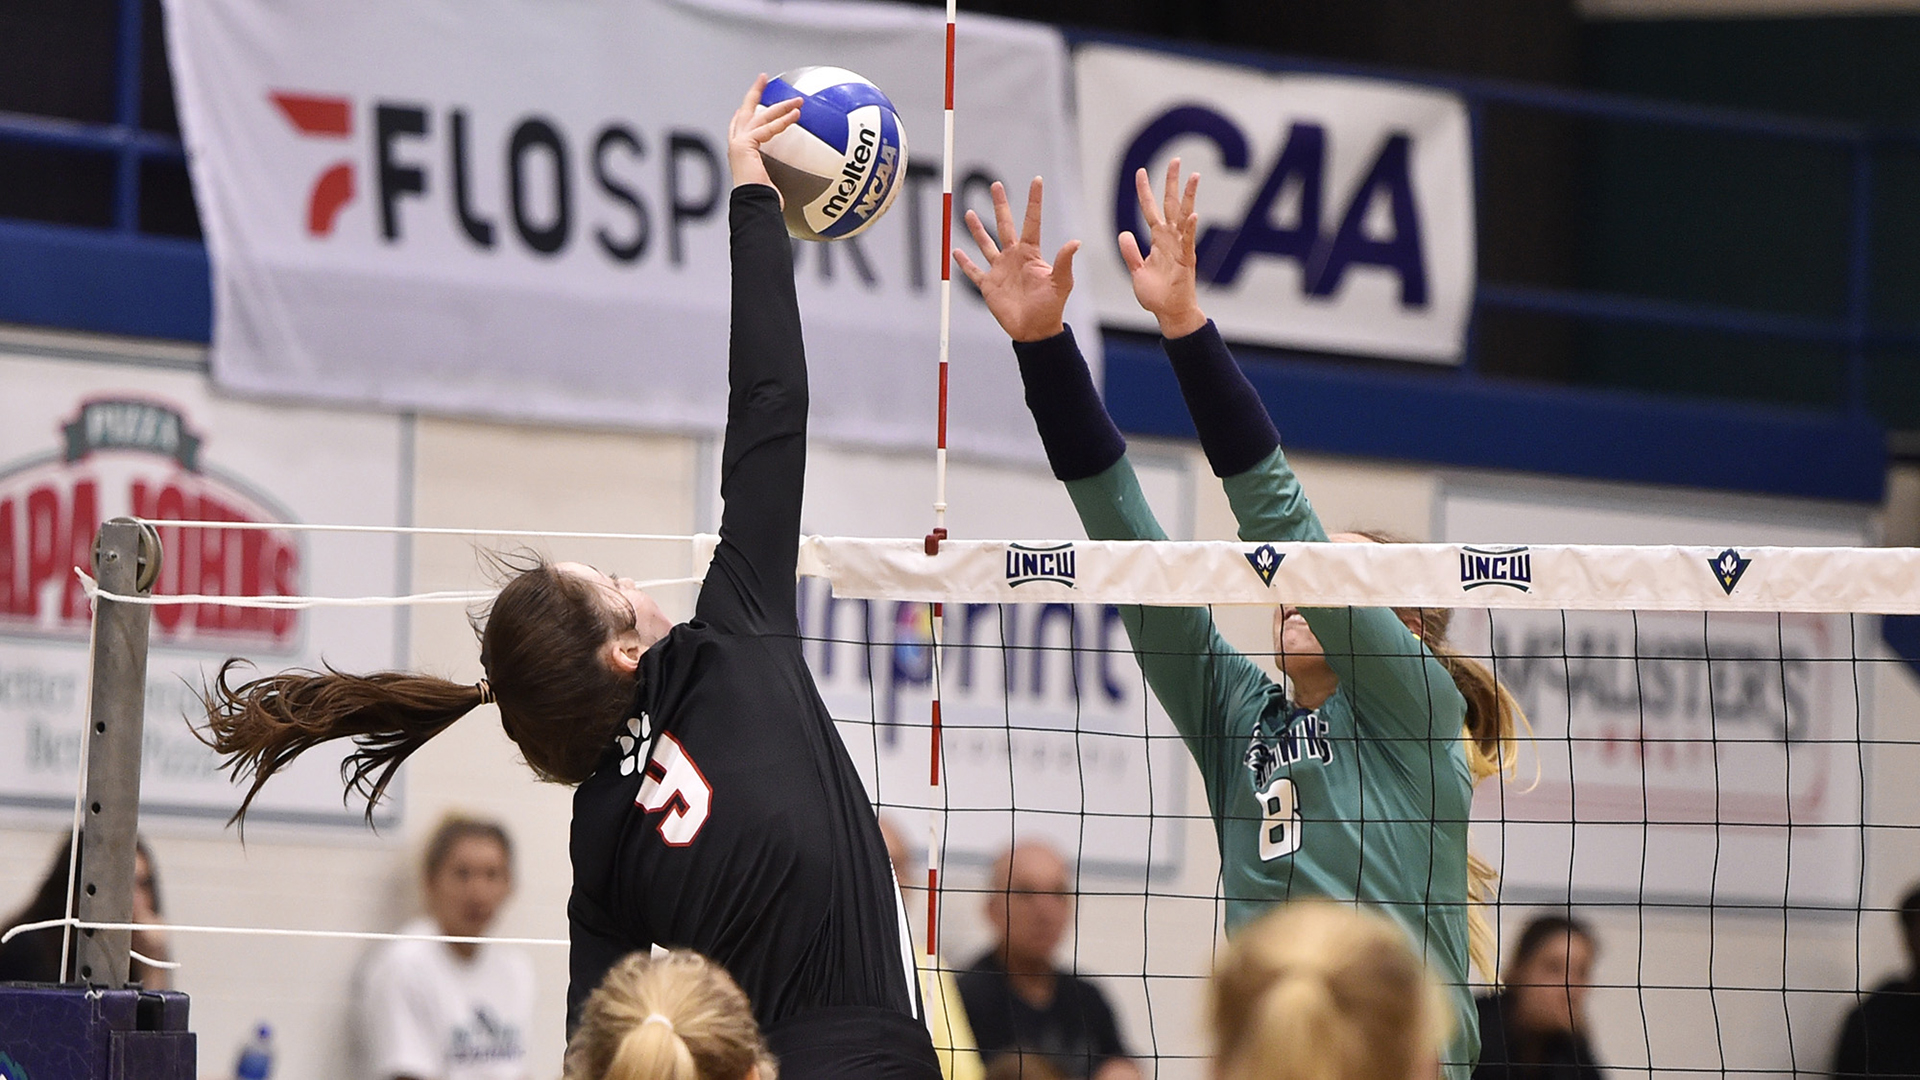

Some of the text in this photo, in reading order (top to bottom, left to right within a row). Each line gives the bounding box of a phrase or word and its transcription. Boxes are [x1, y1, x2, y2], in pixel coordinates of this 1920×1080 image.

[374, 102, 1010, 305] FLOSPTS
[822, 128, 876, 219] molten
[853, 145, 898, 220] NCAA
[1115, 105, 1429, 306] CAA
[1006, 550, 1075, 579] UNCW
[1460, 553, 1531, 583] UNCW
[634, 729, 713, 847] 9
[1256, 777, 1302, 862] 8
